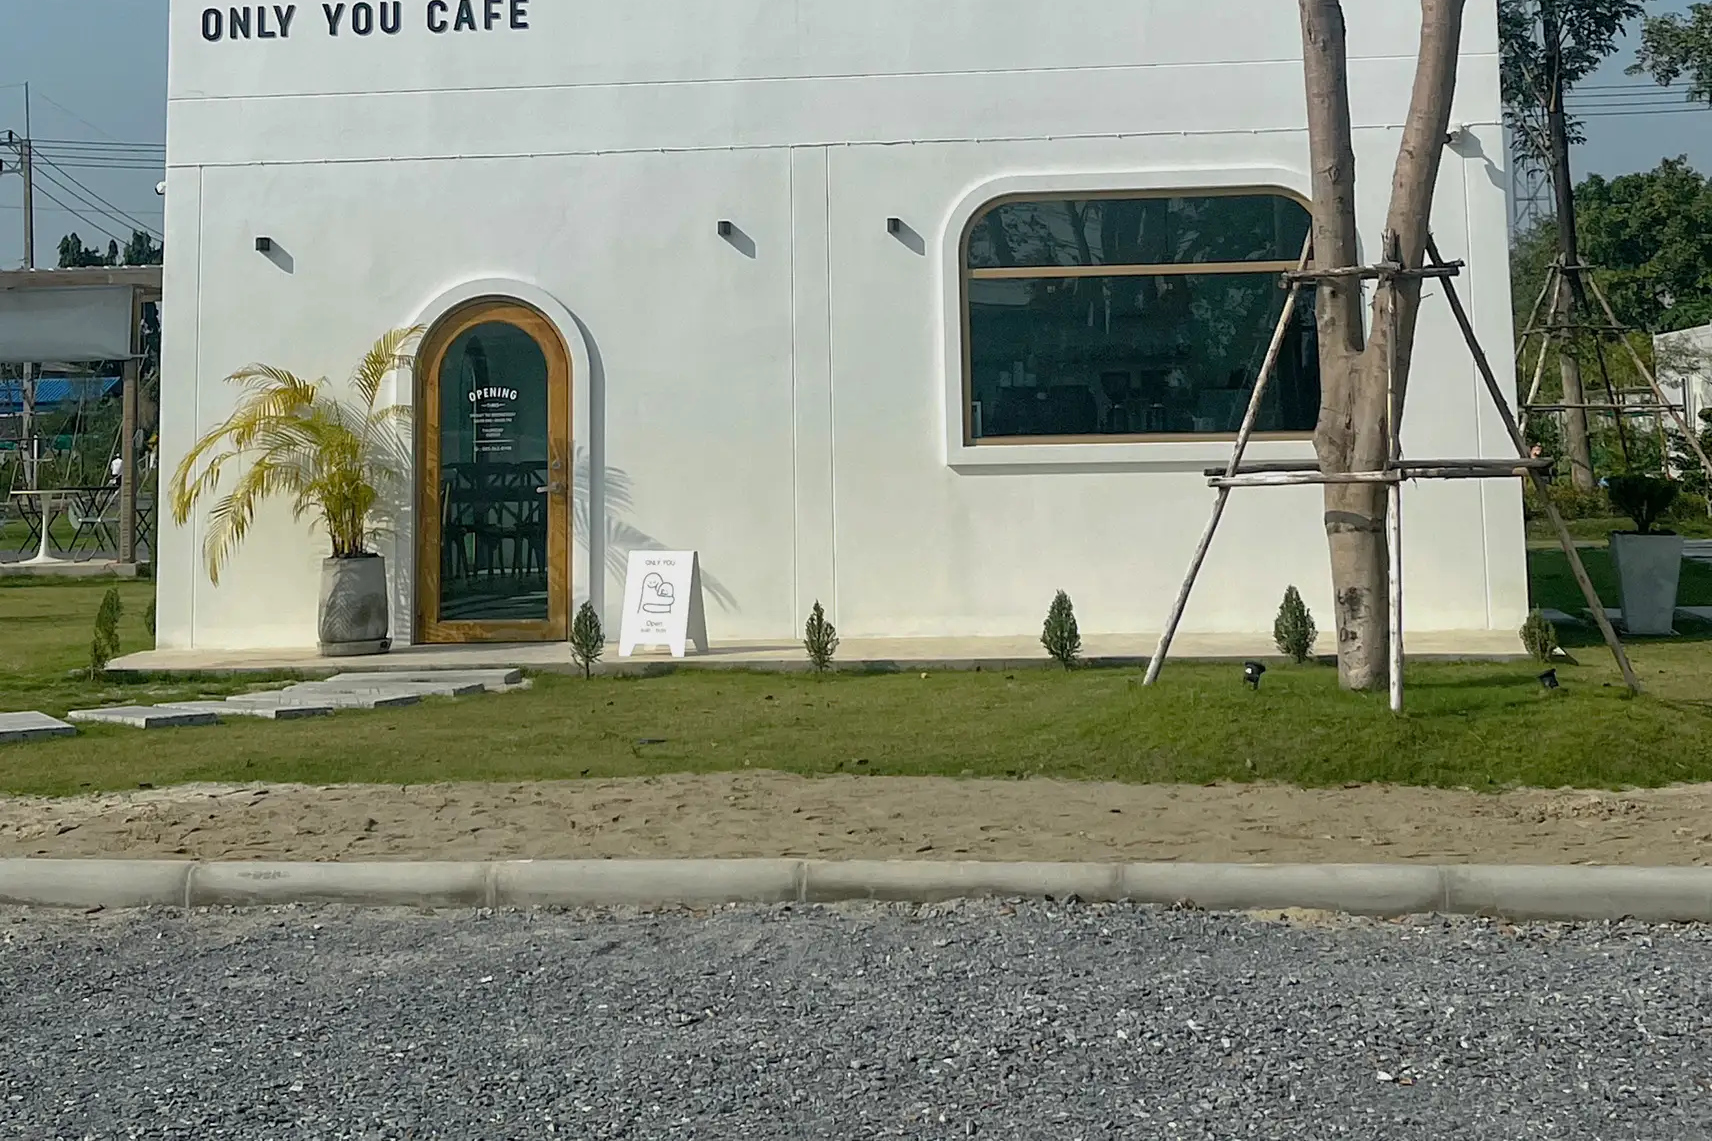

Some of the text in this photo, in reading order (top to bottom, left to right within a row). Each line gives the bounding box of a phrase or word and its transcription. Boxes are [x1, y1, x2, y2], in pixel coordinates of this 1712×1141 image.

[201, 4, 297, 42] ONLY
[322, 0, 403, 37] YOU
[468, 387, 518, 402] OPENING
